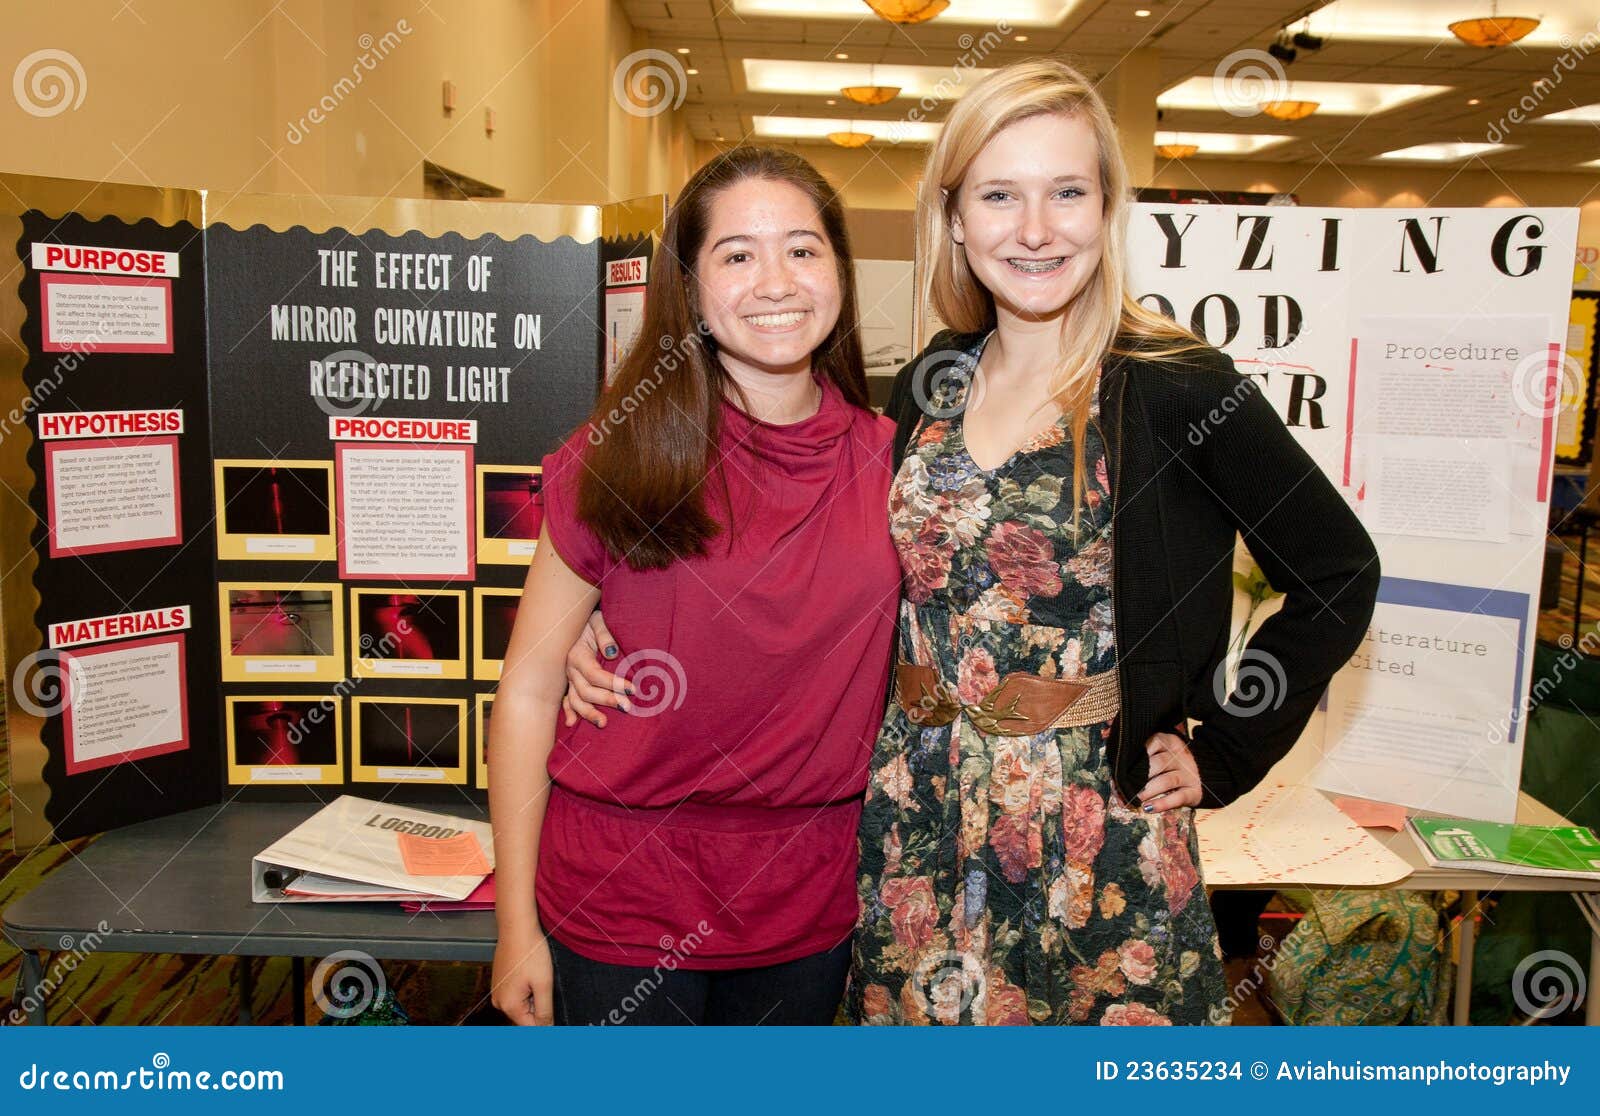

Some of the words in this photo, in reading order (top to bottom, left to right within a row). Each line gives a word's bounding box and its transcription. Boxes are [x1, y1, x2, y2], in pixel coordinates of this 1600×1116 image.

[46, 246, 166, 274] PURPOSE
[318, 249, 358, 288] THE
[375, 252, 452, 291] EFFECT
[467, 255, 492, 292] OF
[611, 260, 641, 283] RESULTS
[271, 304, 357, 343] MIRROR
[374, 308, 497, 349] CURVATURE
[514, 313, 541, 350] ON
[1385, 343, 1519, 361] Procedure
[310, 361, 430, 401] REFLECTED
[447, 366, 511, 403] LIGHT
[43, 412, 180, 436] HYPOTHESIS
[335, 419, 471, 440] PROCEDURE
[55, 609, 184, 645] MATERIALS
[1365, 626, 1488, 657] iterature
[1350, 654, 1416, 677] Cited
[365, 814, 463, 839] LOGBOO
